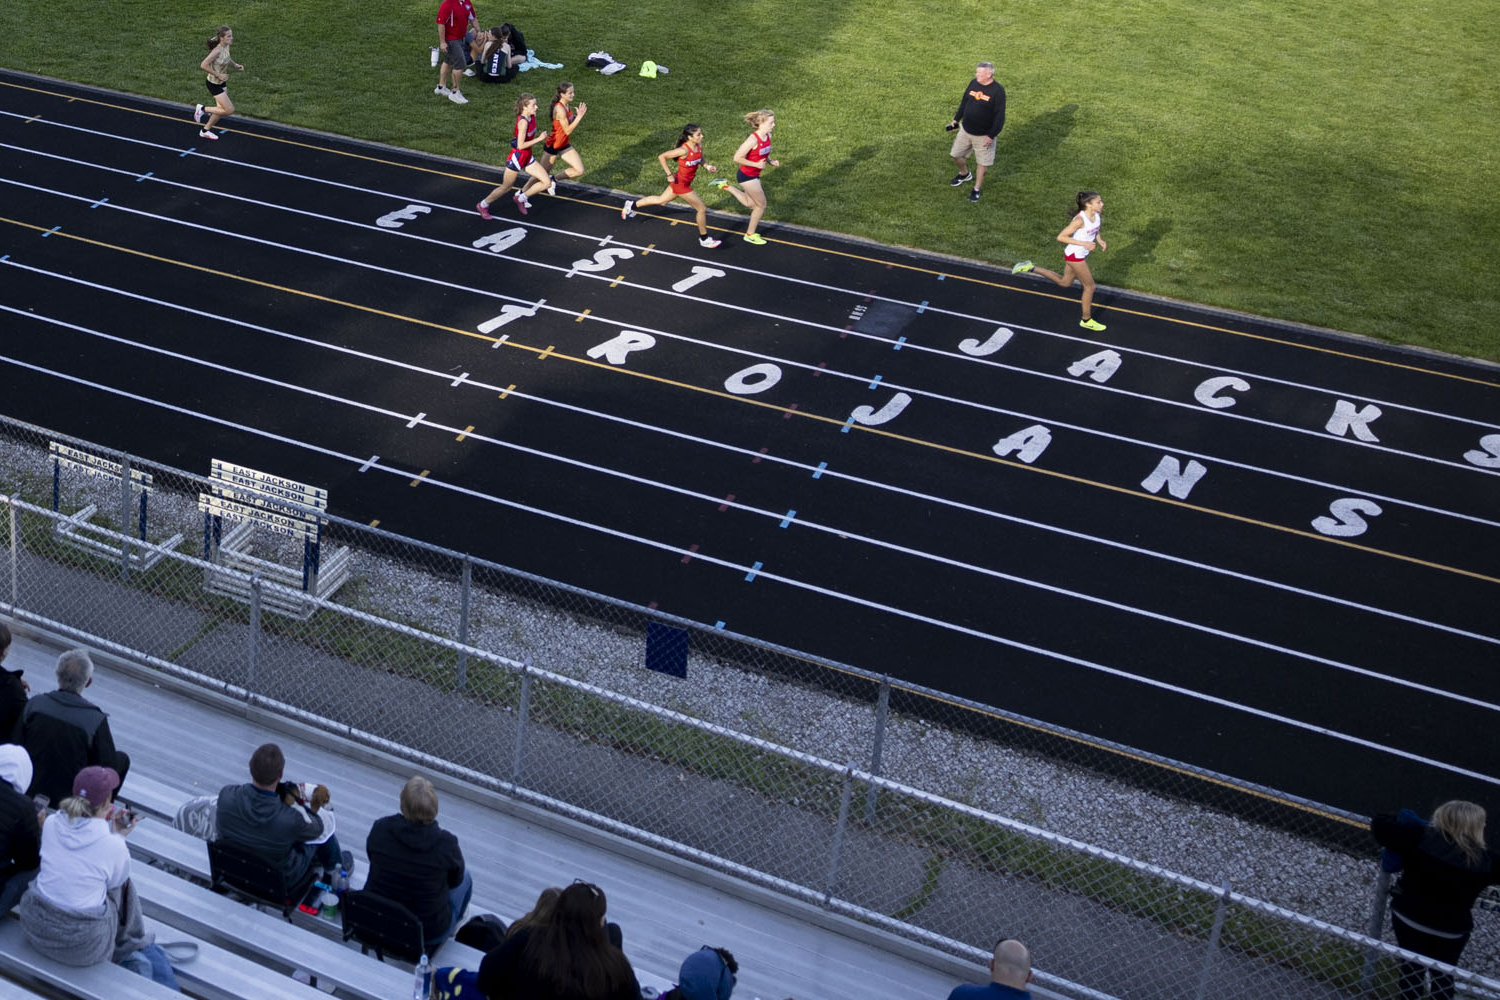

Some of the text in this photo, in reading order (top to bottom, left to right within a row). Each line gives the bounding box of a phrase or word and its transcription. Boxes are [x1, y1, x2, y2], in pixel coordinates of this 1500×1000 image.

[376, 204, 726, 293] EAST
[476, 303, 1383, 537] TROJANS
[68, 449, 89, 462] EAST
[233, 466, 306, 493] EAST JACKSON
[233, 475, 305, 502] EAST JACKSON
[220, 500, 295, 527] EAST JACKSON
[220, 510, 294, 537] EAST JACKSON
